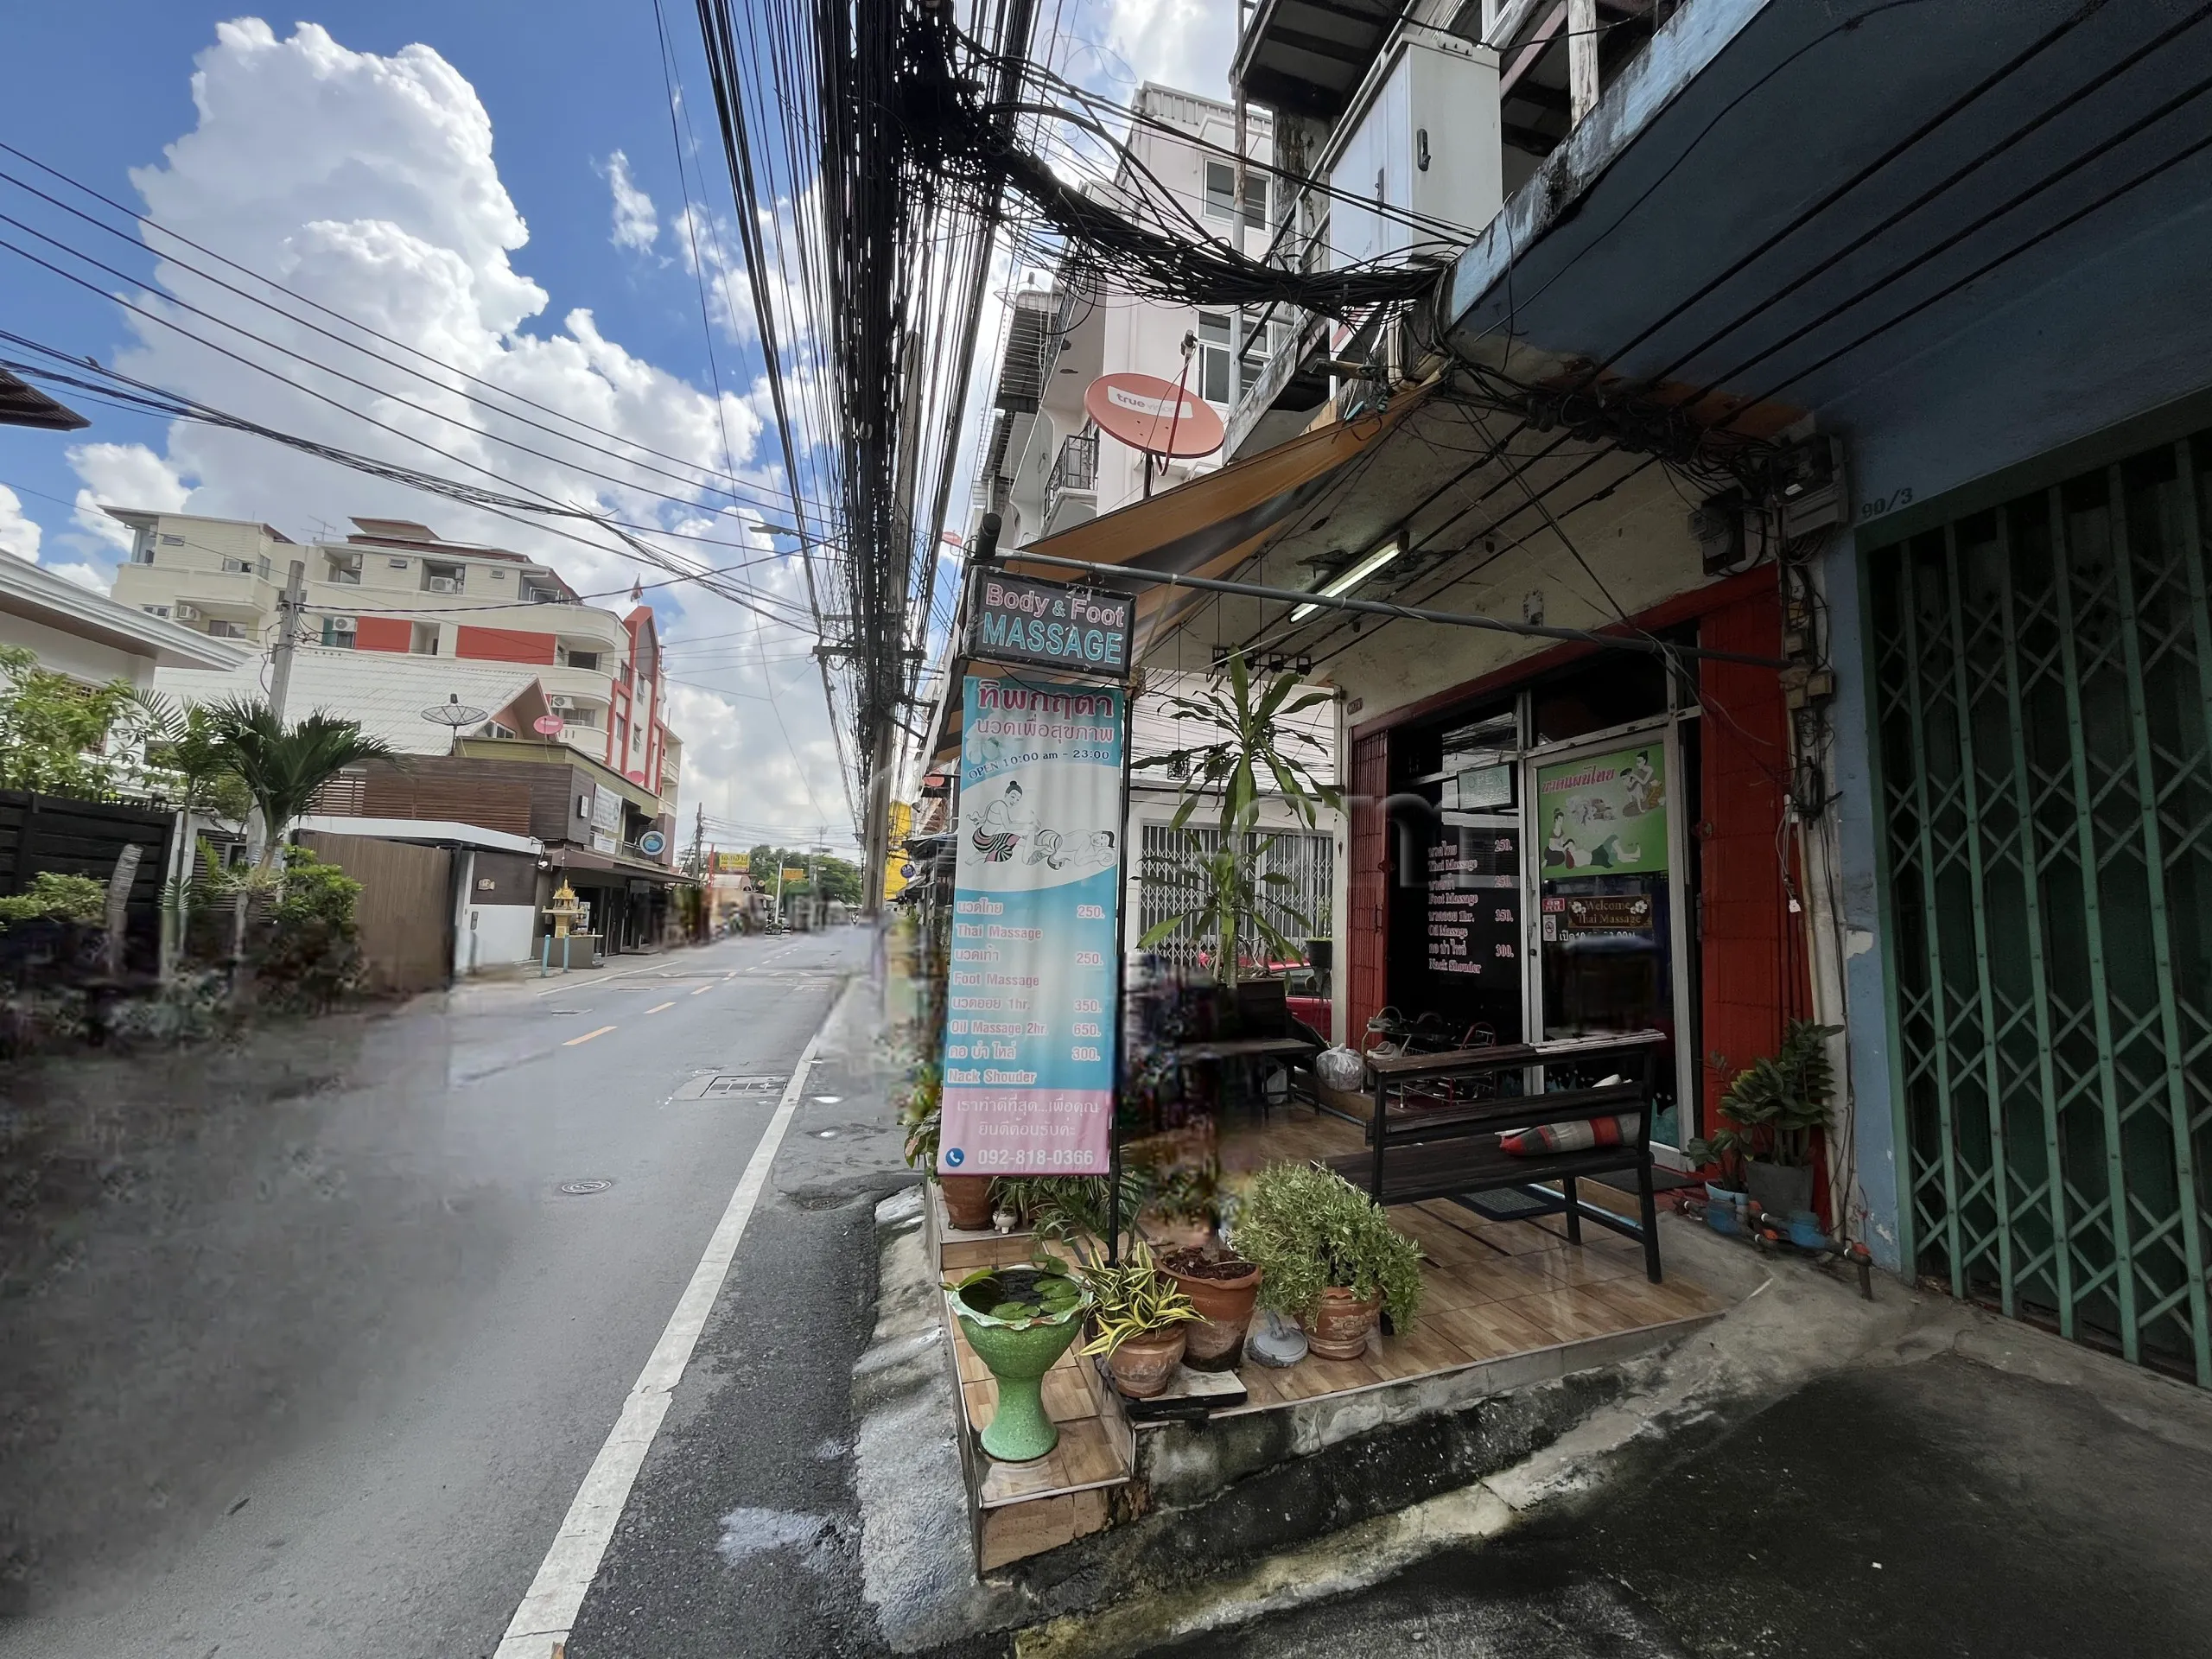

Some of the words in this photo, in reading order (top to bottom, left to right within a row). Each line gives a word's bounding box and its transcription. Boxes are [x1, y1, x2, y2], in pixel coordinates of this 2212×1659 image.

[1116, 393, 1146, 408] true
[1861, 487, 1913, 517] 90/3
[986, 582, 1050, 618] Body
[1052, 600, 1065, 617] &
[1071, 598, 1125, 628] Foot
[982, 612, 1123, 664] MASSAGE
[979, 680, 1114, 720] ทิพกฤตา
[977, 715, 1114, 744] นวดเพื่อสุขภาพ
[969, 761, 999, 779] OPEN
[1003, 752, 1039, 767] 10:00
[1072, 749, 1109, 760] 23:00
[1445, 859, 1478, 871] Massage
[957, 899, 1003, 915] นวดไทย
[1446, 893, 1478, 906] Massage
[1585, 899, 1631, 911] Welcome
[1577, 913, 1597, 924] Thai
[1599, 914, 1642, 926] Massage
[957, 925, 983, 938] Thai
[988, 926, 1042, 941] Massage
[1440, 925, 1469, 939] Massage
[954, 944, 1000, 962] นวดเท้า
[953, 972, 982, 985] Foot
[987, 973, 1039, 988] Massage
[952, 998, 1001, 1010] นวดออย
[950, 1020, 968, 1034] Oil
[971, 1021, 1021, 1036] Massage
[949, 1046, 968, 1058] คอ
[992, 1041, 1016, 1059] ไหล่
[948, 1068, 980, 1083] Nack
[983, 1070, 1037, 1084] Shouder
[978, 1149, 1094, 1165] 092-818-0366
